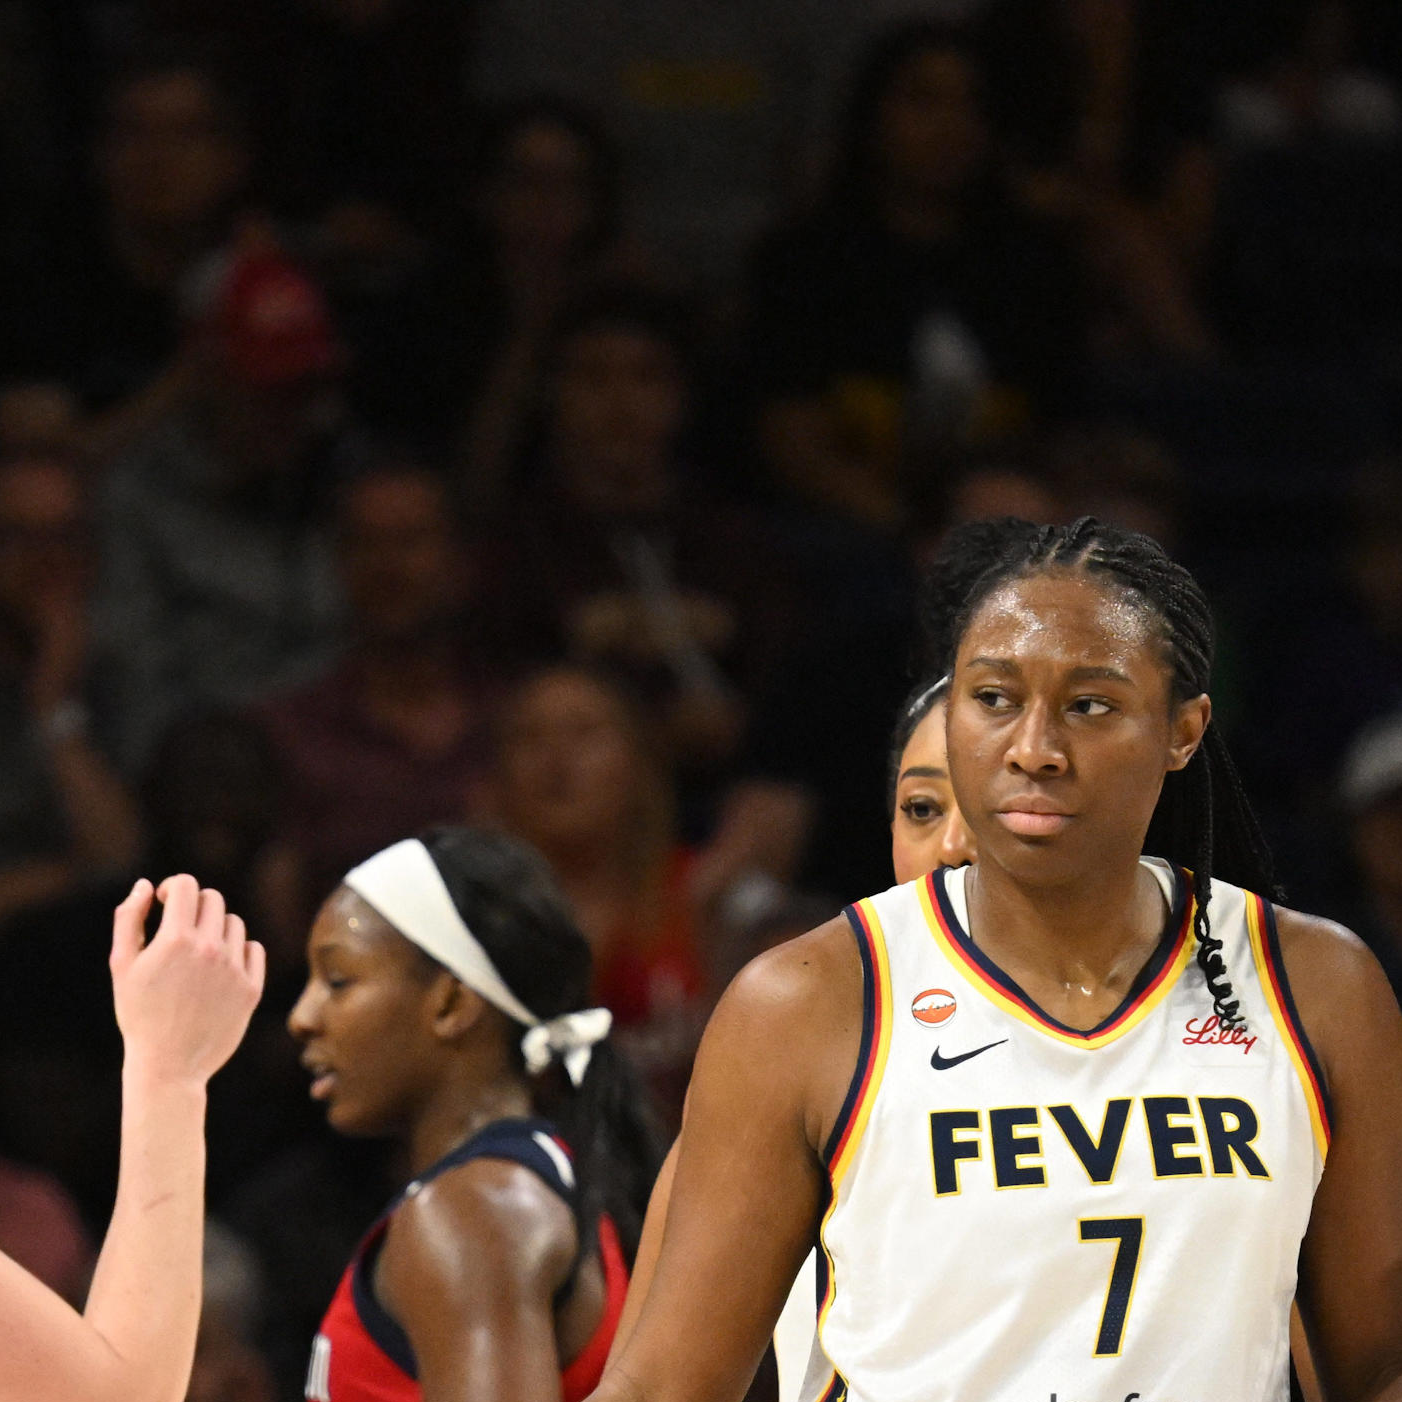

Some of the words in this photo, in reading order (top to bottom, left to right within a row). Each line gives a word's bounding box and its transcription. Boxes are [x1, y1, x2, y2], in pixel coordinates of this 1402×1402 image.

[1182, 1015, 1258, 1055] Lilly
[929, 1094, 1273, 1198] FEVER
[1077, 1214, 1146, 1359] 7
